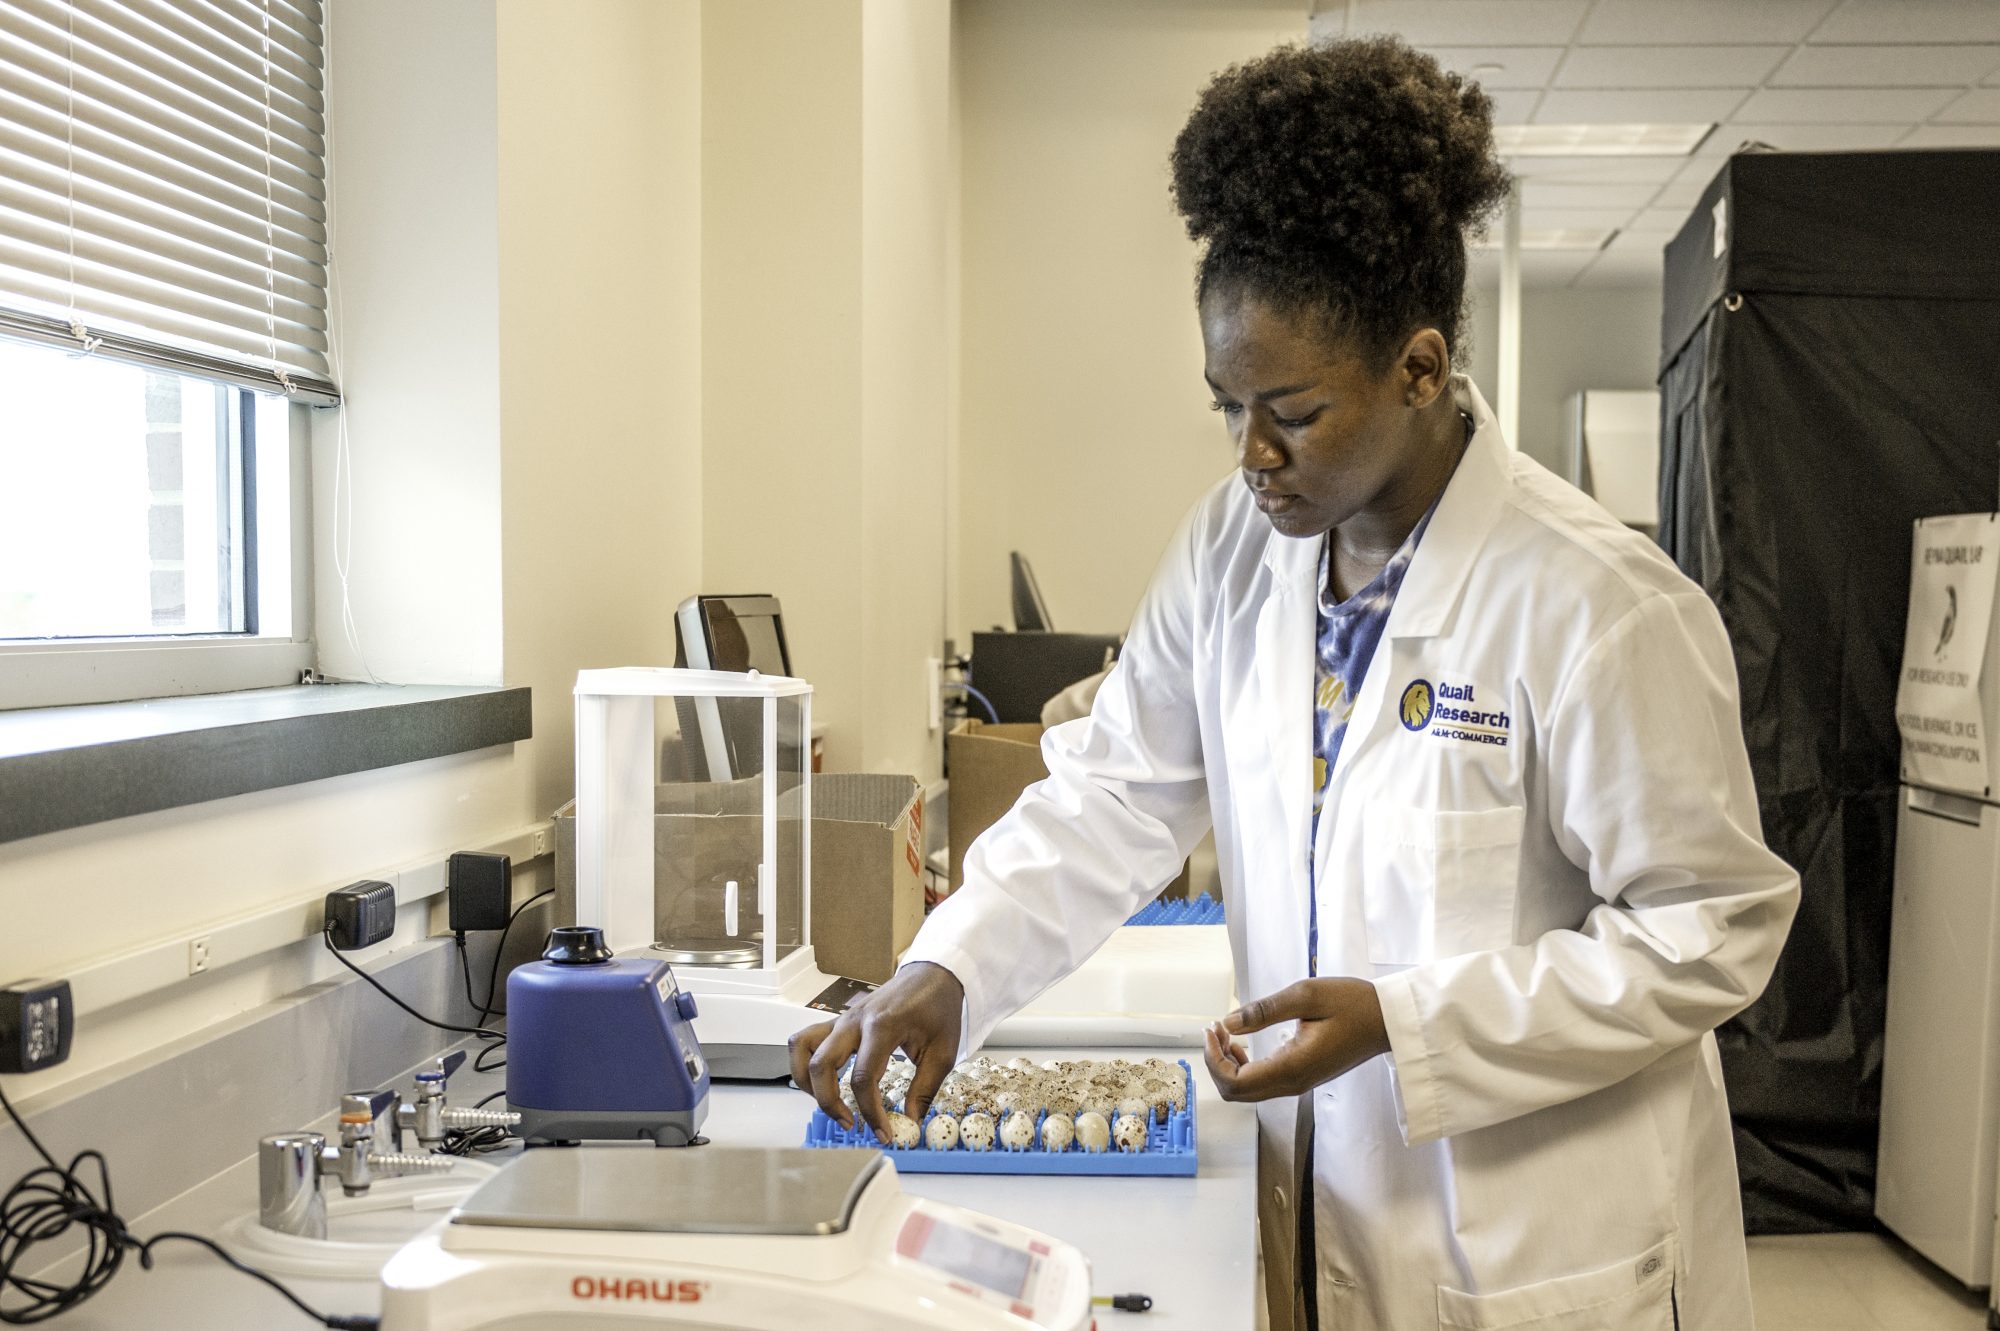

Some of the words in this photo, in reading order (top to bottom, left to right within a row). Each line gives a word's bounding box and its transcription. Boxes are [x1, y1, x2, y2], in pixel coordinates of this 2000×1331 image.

[1439, 682, 1475, 702] Quail
[1434, 702, 1510, 729] Research
[571, 1275, 702, 1304] OHAUS
